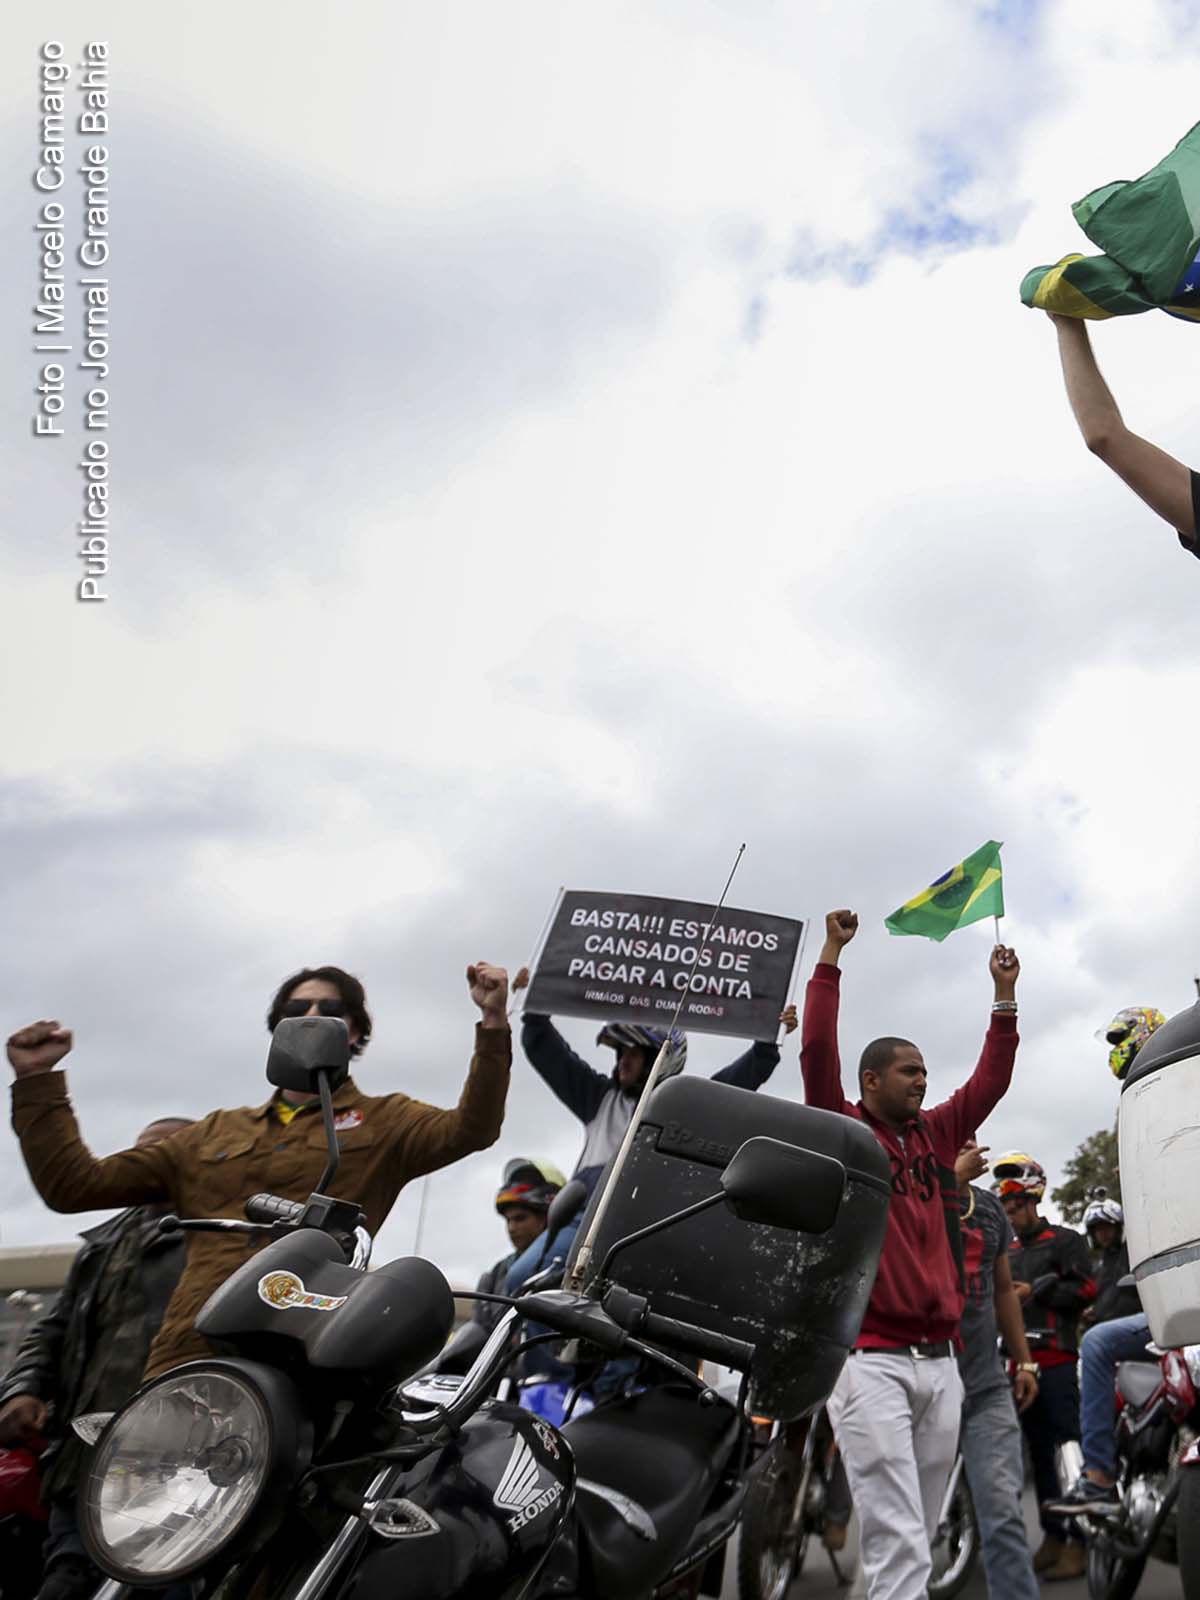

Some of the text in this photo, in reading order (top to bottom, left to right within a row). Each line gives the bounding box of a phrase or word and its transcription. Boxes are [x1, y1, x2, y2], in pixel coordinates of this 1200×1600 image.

[570, 909, 779, 951] BASTA!!! ESTAMOS
[584, 934, 751, 973] CANSADOS DE
[568, 958, 752, 999] PAGAR A CONTA
[629, 995, 650, 1008] DAS
[688, 1003, 724, 1017] RODAS
[508, 1481, 565, 1534] HONDA
